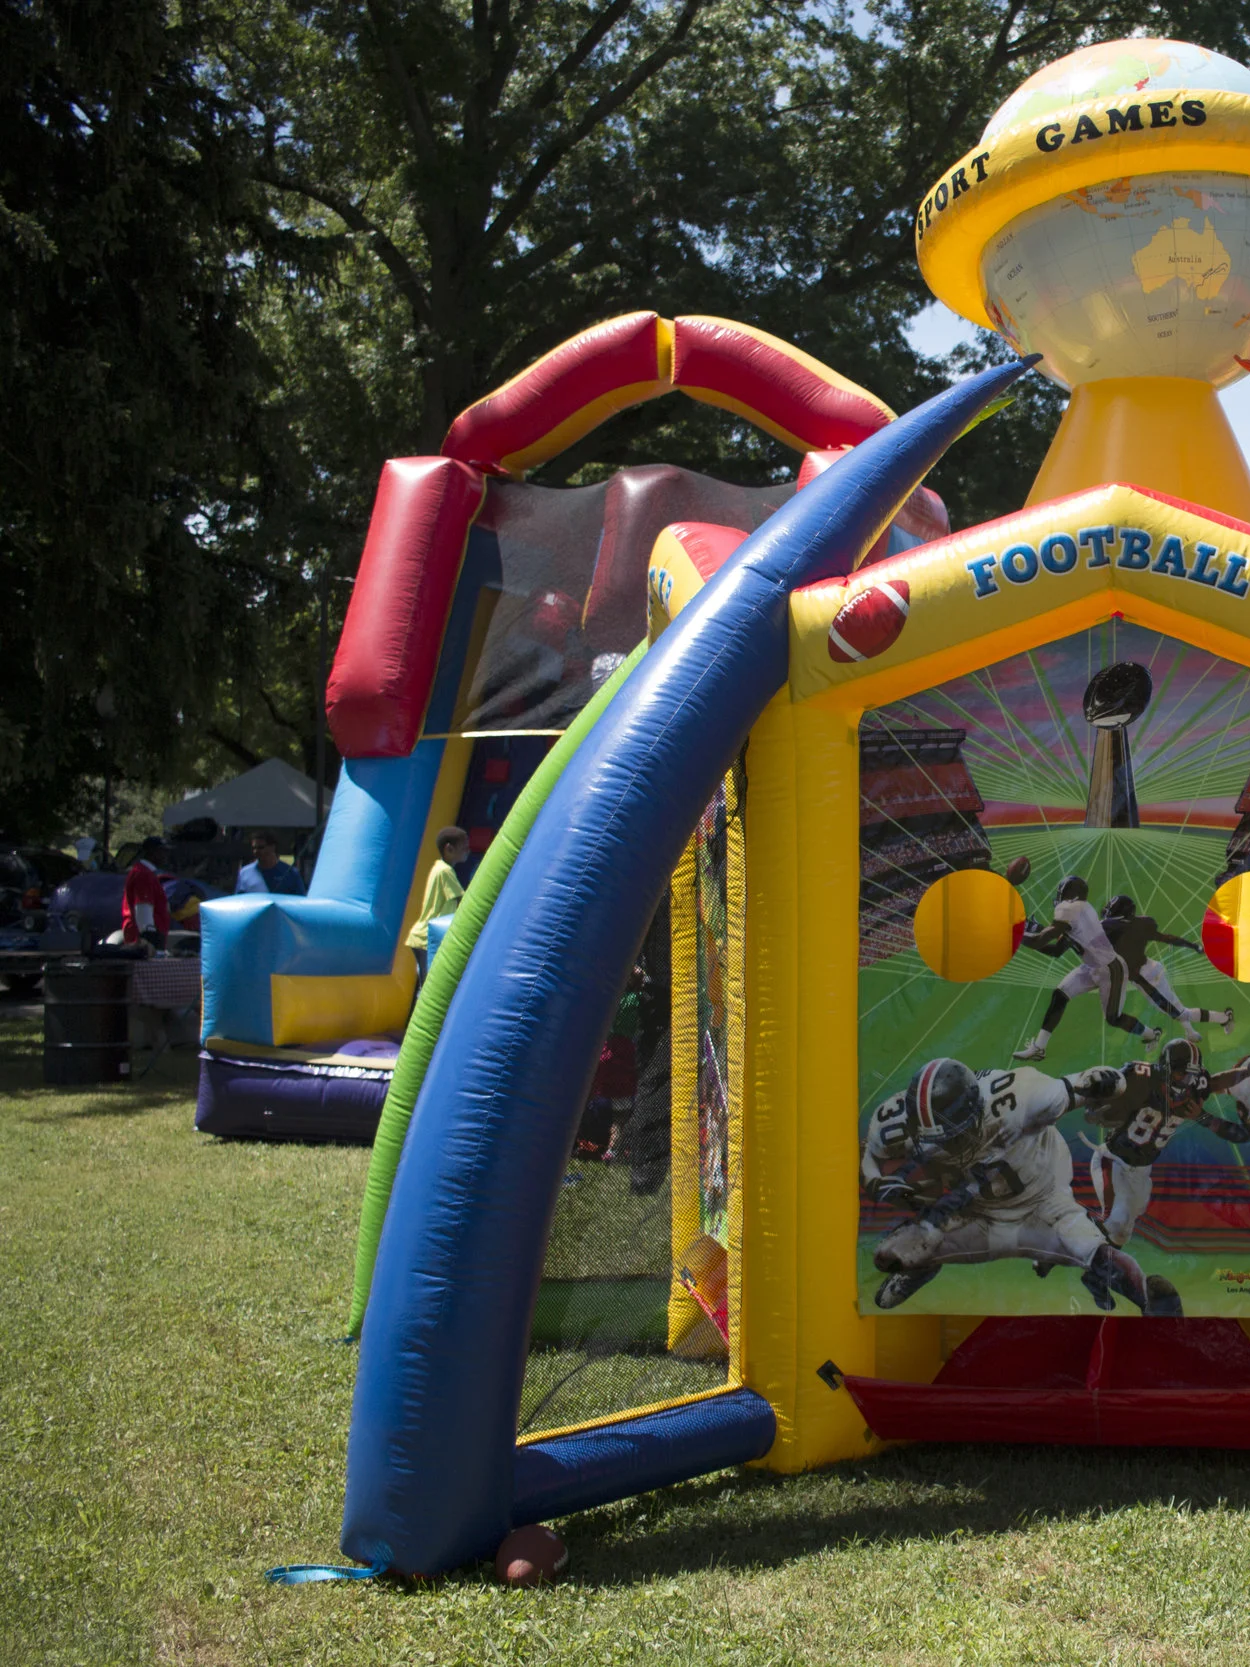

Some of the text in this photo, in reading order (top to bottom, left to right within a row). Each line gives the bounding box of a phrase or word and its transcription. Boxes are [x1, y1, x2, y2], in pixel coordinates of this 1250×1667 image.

[917, 99, 1207, 241] SPORT GAMES
[1168, 255, 1202, 264] Australia
[1147, 309, 1179, 323] SOUTHERN
[966, 525, 1250, 600] FOOTBALL
[991, 1072, 1017, 1118] 30
[1226, 1286, 1238, 1294] Los
